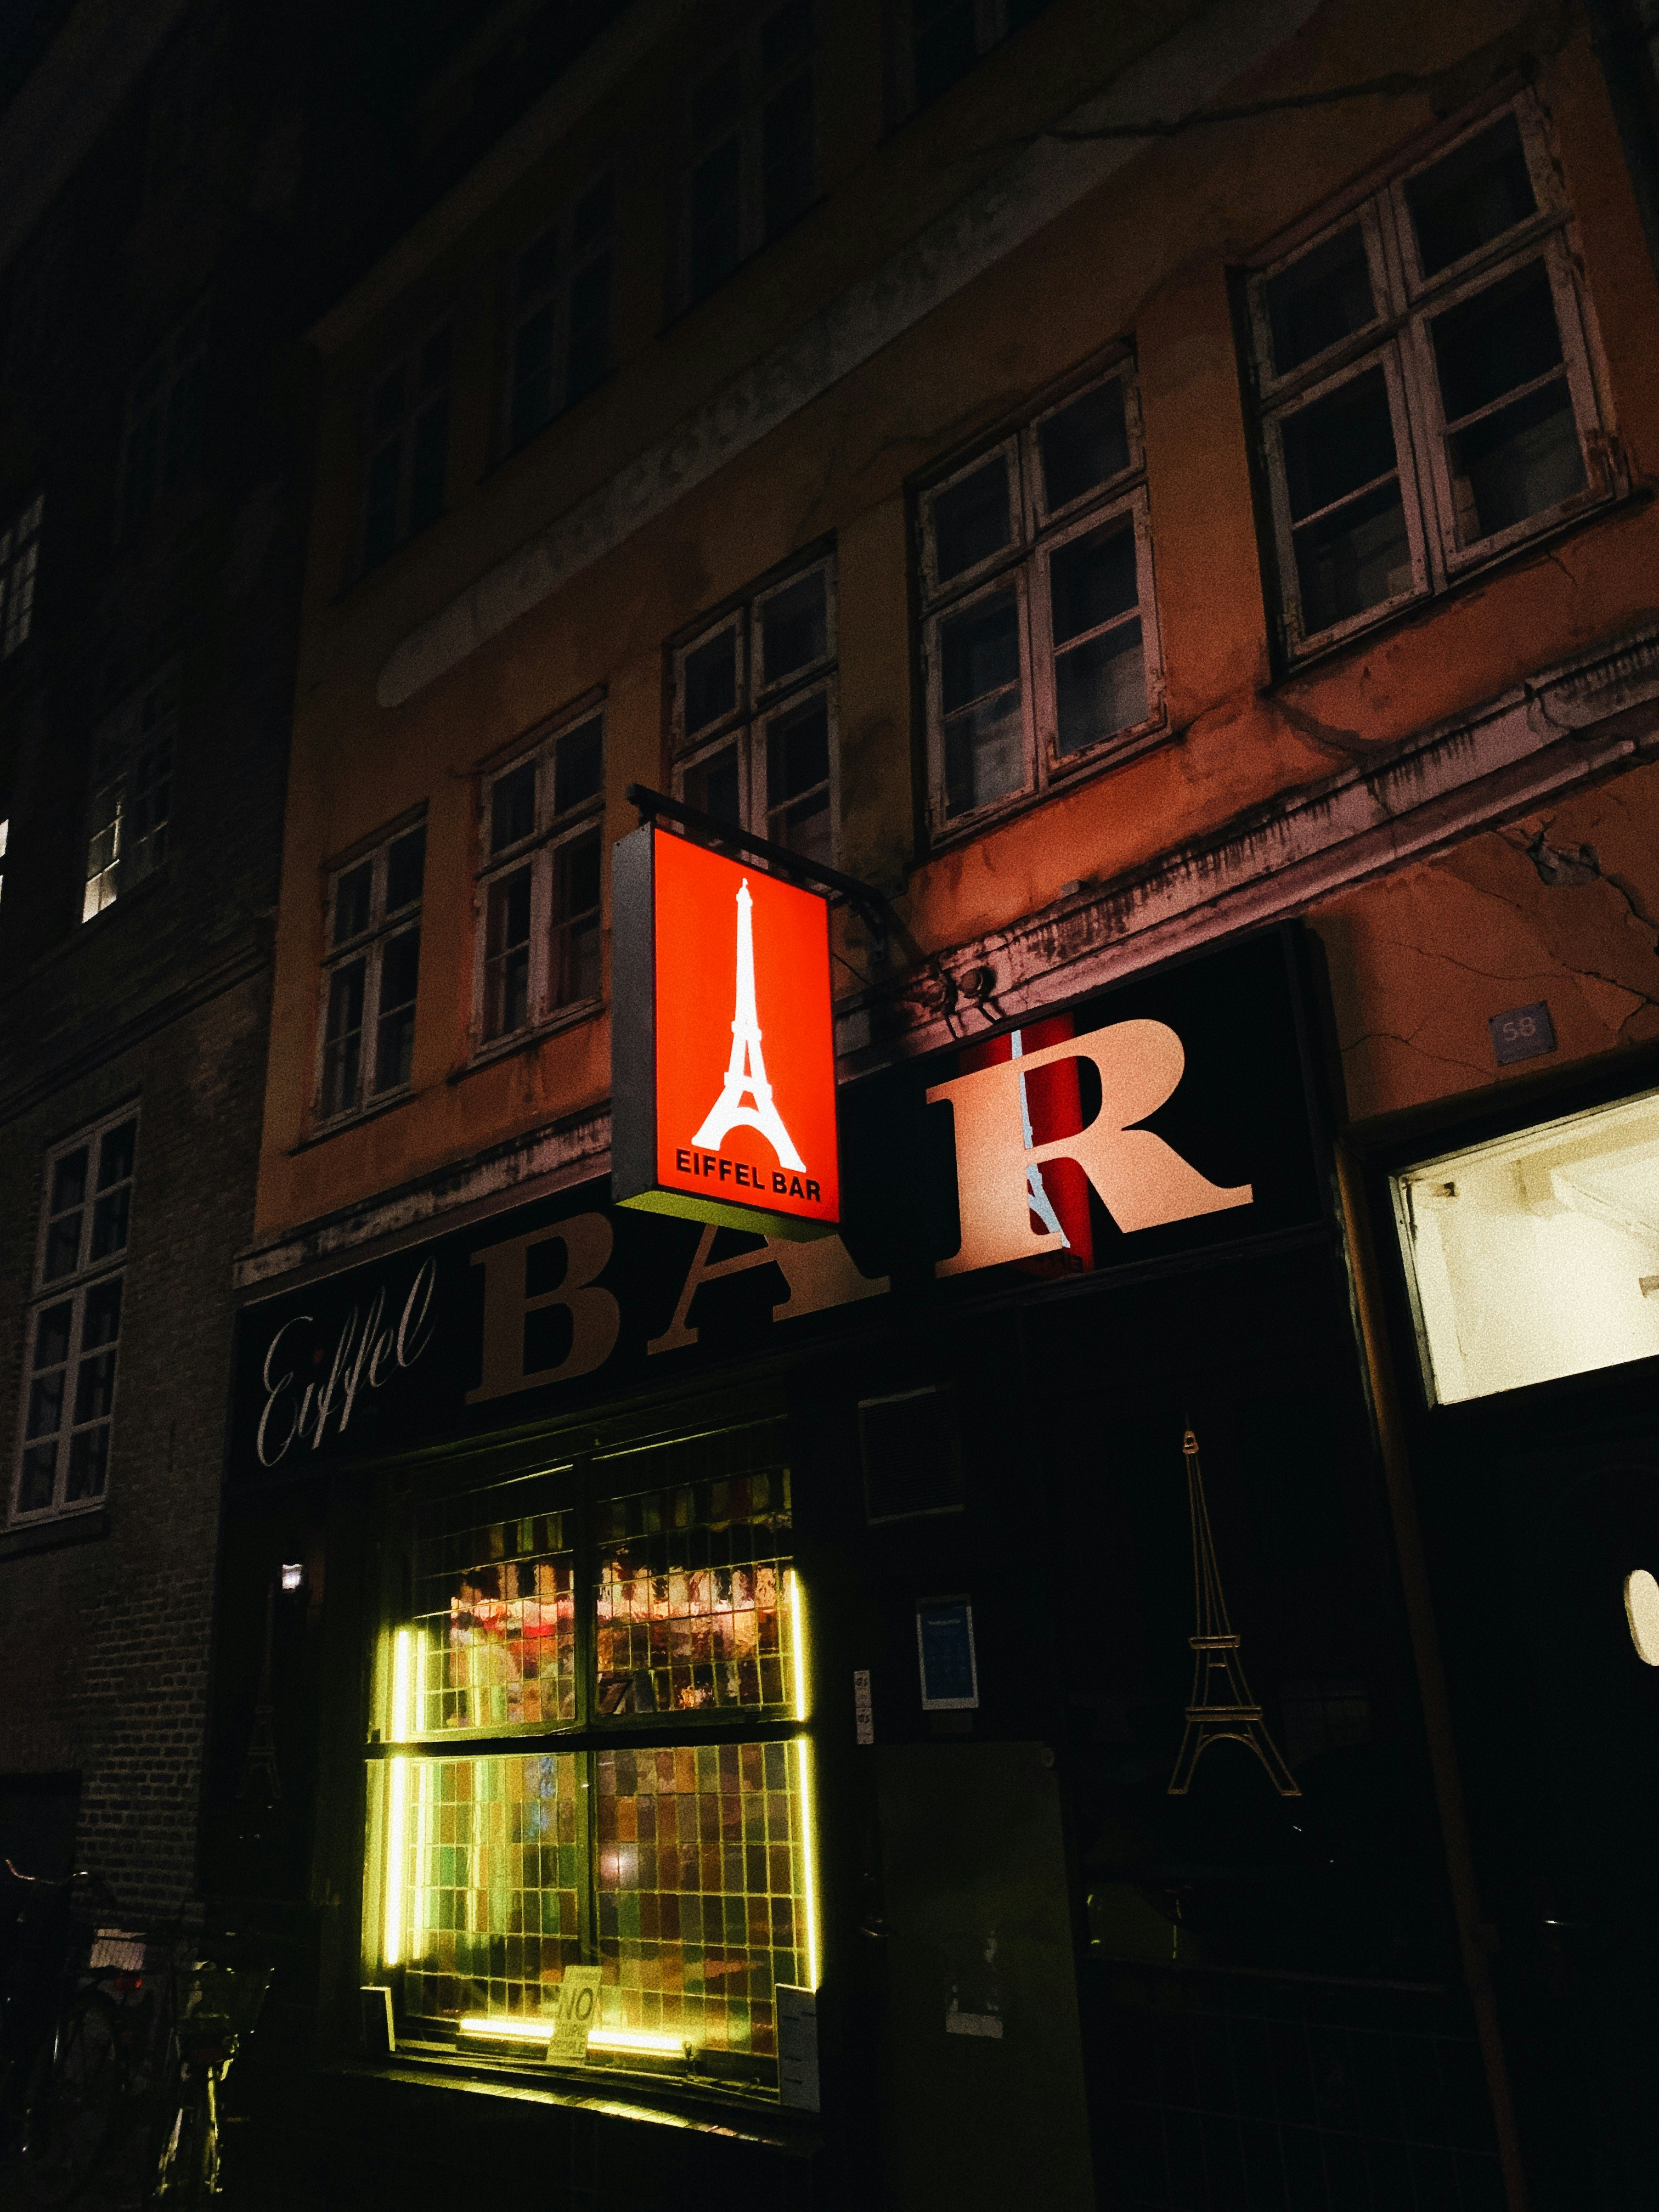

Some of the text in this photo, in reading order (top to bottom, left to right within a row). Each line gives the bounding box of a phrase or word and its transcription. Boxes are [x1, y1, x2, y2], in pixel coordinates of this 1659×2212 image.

[257, 1018, 1254, 1466] Eiffel BAR
[676, 1148, 821, 1202] EIFFEL BAR
